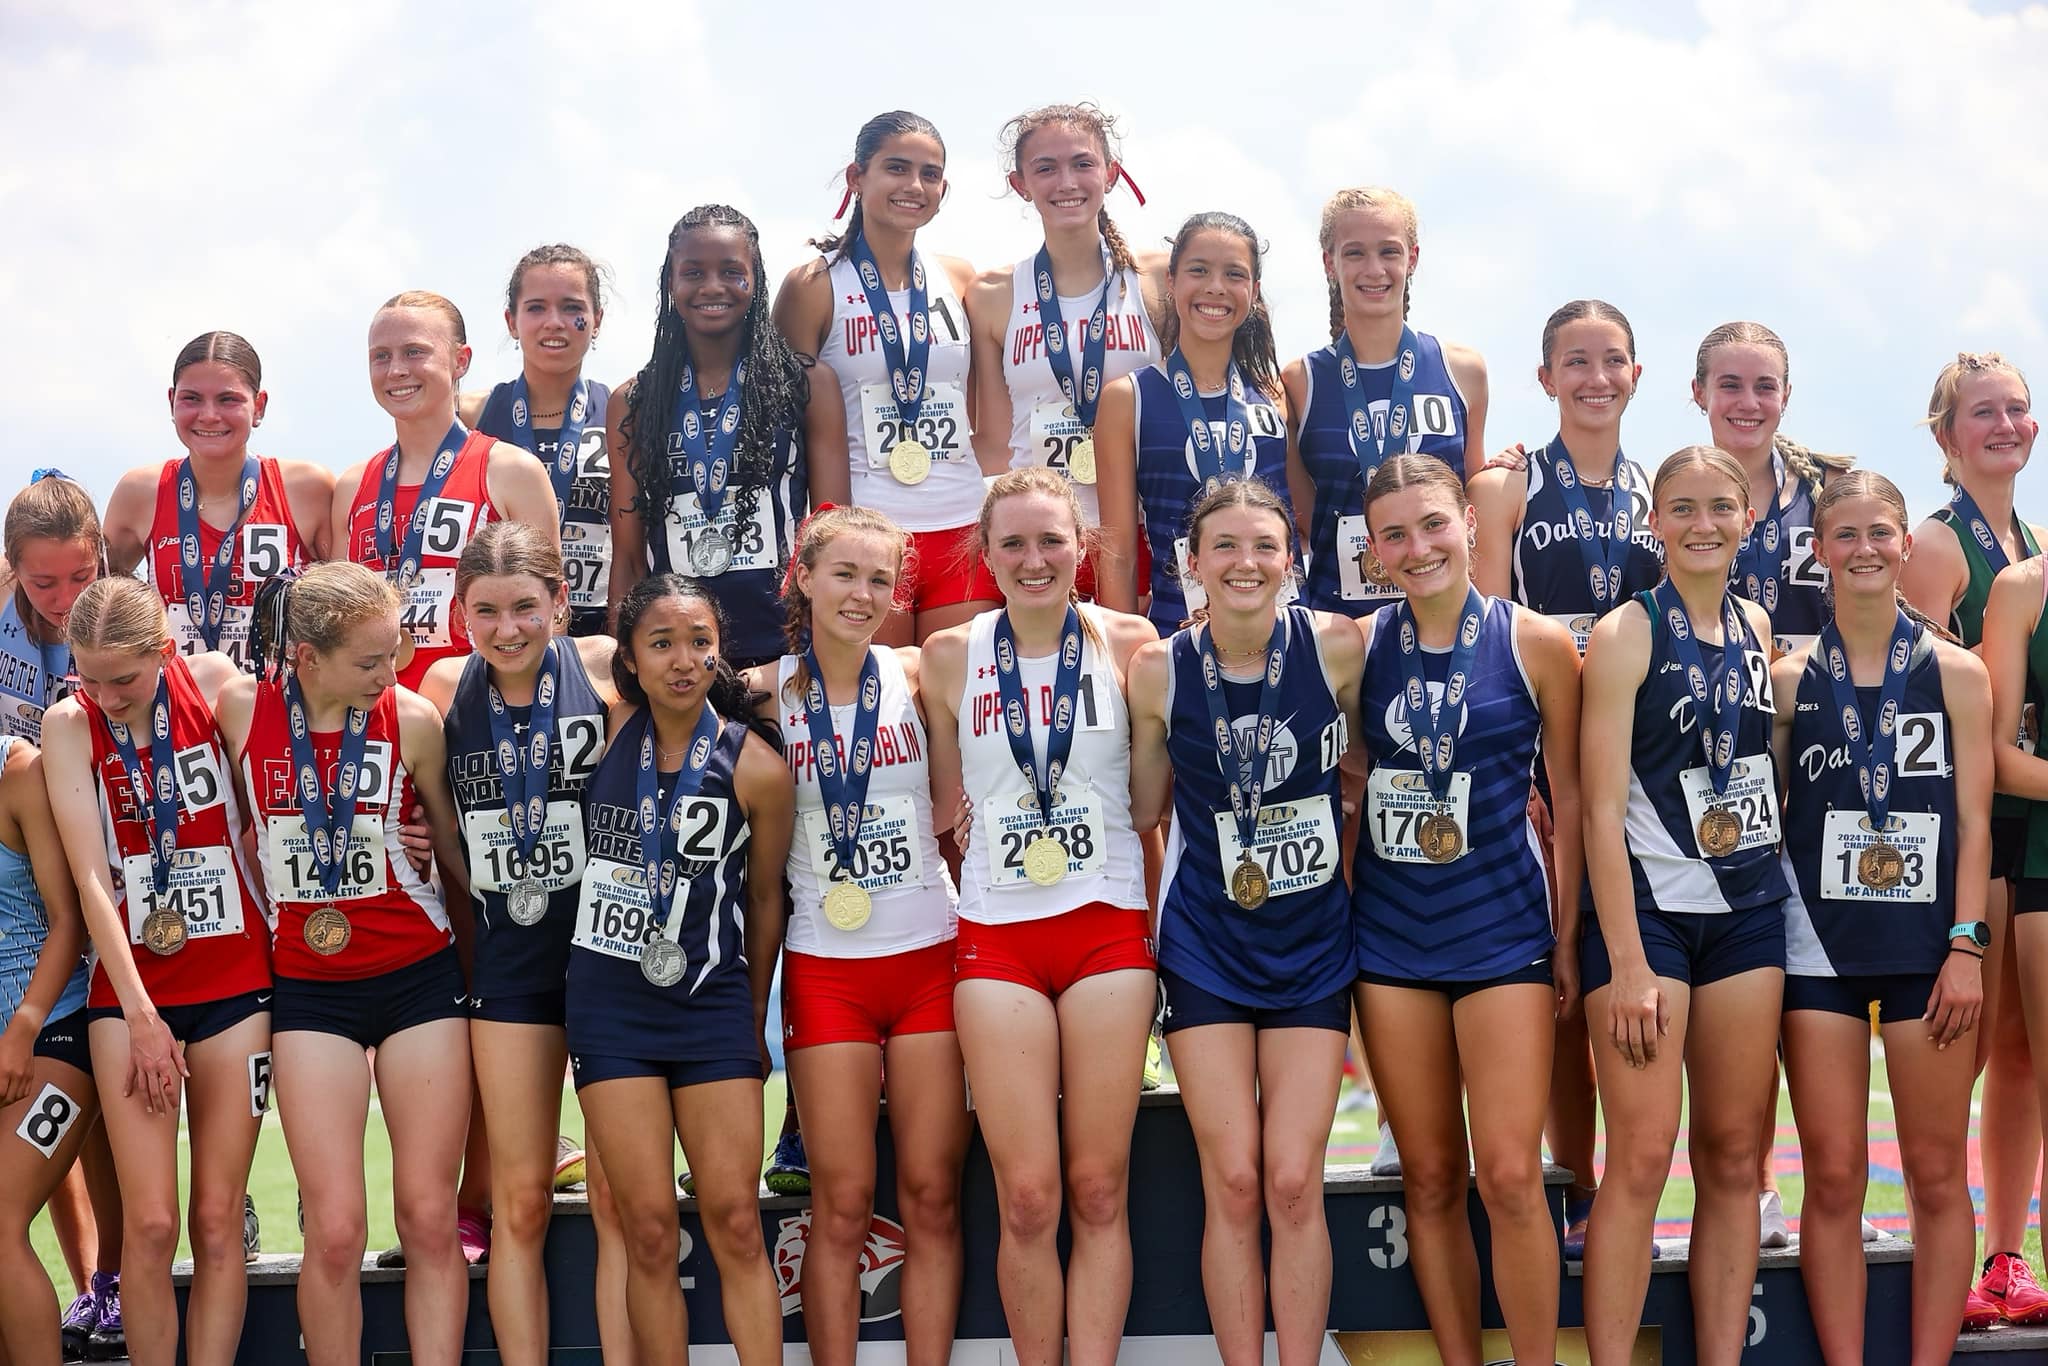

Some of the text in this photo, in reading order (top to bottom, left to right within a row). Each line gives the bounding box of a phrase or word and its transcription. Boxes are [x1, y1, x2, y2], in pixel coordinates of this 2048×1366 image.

[929, 297, 960, 341] 1
[874, 405, 897, 414] 2024
[933, 401, 954, 410] FIELD
[1248, 404, 1277, 436] 0
[1043, 421, 1065, 430] 2024
[581, 430, 610, 474] 2
[1044, 435, 1084, 468] 20
[428, 502, 464, 552] 5
[1632, 491, 1653, 532] 2
[250, 528, 281, 577] 5
[583, 544, 603, 553] FIELD
[1795, 530, 1825, 582] 2
[563, 558, 603, 592] 97
[400, 605, 438, 634] 44
[0, 650, 38, 696] ORTH
[1752, 655, 1771, 709] 2
[1078, 673, 1098, 727] 1
[566, 719, 598, 775] 2
[1901, 717, 1938, 772] 2
[178, 749, 217, 806] 5
[1697, 788, 1713, 799] 202
[1750, 777, 1766, 786] FIELD
[1376, 791, 1394, 801] 2024
[1396, 793, 1425, 802] TRACK
[1380, 800, 1451, 812] CHAMPIONSHPS
[481, 823, 570, 841] 2024 FIELD
[683, 801, 719, 856] 2
[884, 819, 906, 829] FIELD
[998, 814, 1022, 825] 2024
[1065, 806, 1089, 817] FIELD
[1257, 827, 1287, 838] TRACK
[1296, 818, 1321, 829] FIELD
[1376, 808, 1455, 845] 170
[282, 838, 306, 846] 2024
[1837, 833, 1861, 842] 2024
[1903, 836, 1926, 844] FIELD
[169, 871, 194, 881] RACK
[204, 868, 226, 877] FIELD
[484, 840, 574, 883] 1695
[823, 836, 911, 882] 2035
[1837, 850, 1924, 888] 13
[313, 886, 364, 899] ATLETIC
[592, 881, 611, 892] 2024
[612, 886, 640, 898] TRACK
[1269, 873, 1319, 892] ATHLETIC
[1845, 886, 1912, 899] MF ATHLETIC
[142, 885, 226, 922] 1451
[596, 891, 653, 910] CHAMPIONSHI
[590, 899, 668, 946] 1698
[604, 939, 643, 957] ATHLETI
[254, 1056, 271, 1111] 5
[27, 1094, 71, 1147] 8
[1367, 1204, 1408, 1270] 3
